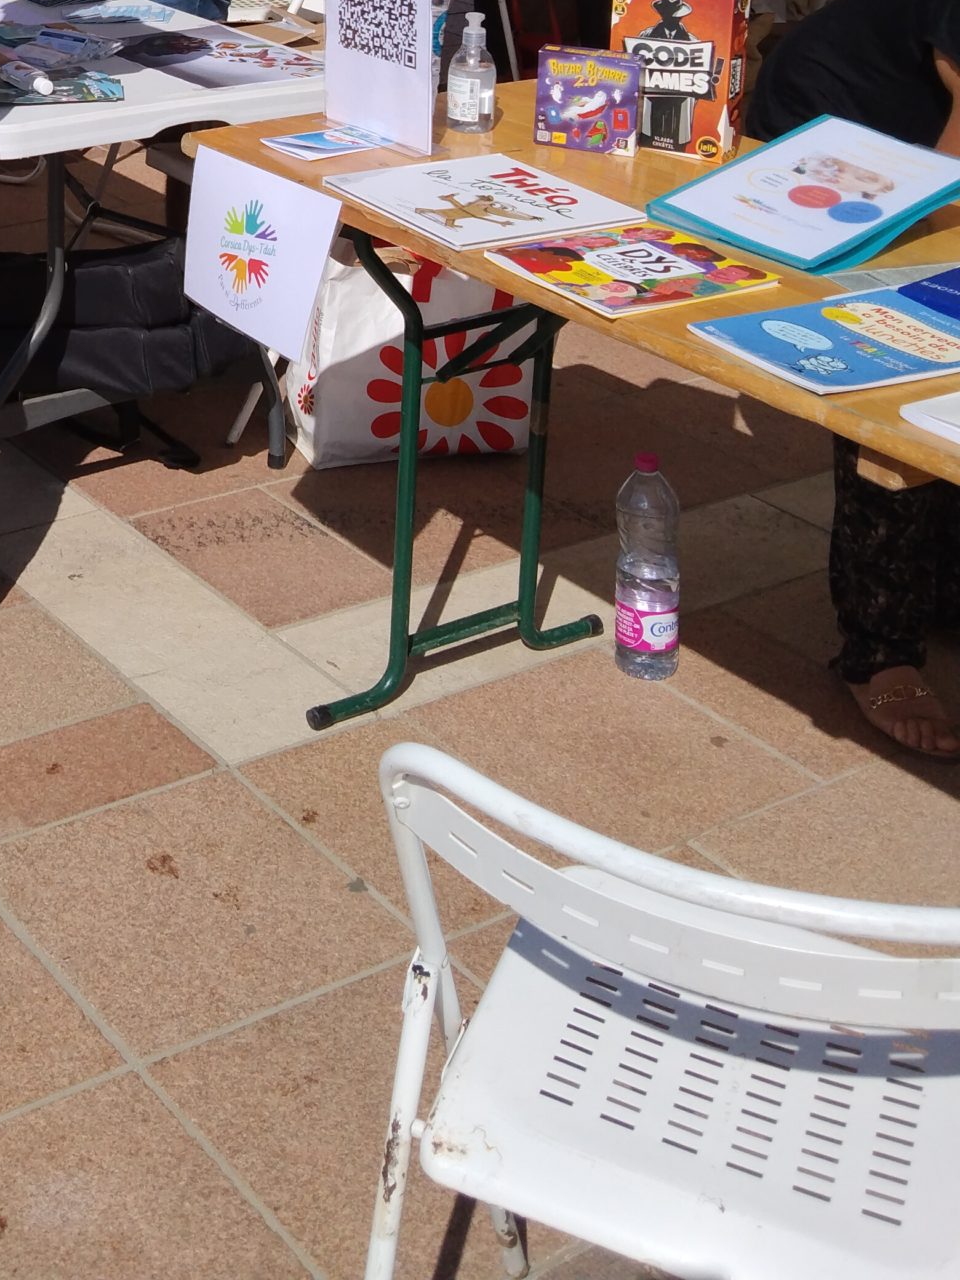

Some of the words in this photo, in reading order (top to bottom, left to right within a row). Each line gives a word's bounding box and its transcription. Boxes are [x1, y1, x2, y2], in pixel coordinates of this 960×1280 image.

[632, 42, 704, 68] CODE
[573, 75, 598, 88] 2.0
[490, 167, 578, 206] THÉO
[220, 235, 242, 250] Corsica
[615, 248, 683, 274] DYS
[860, 323, 946, 360] lunettes
[870, 307, 903, 324] Mon
[907, 324, 960, 350] cervea
[876, 319, 926, 342] besoin
[928, 341, 949, 352] de
